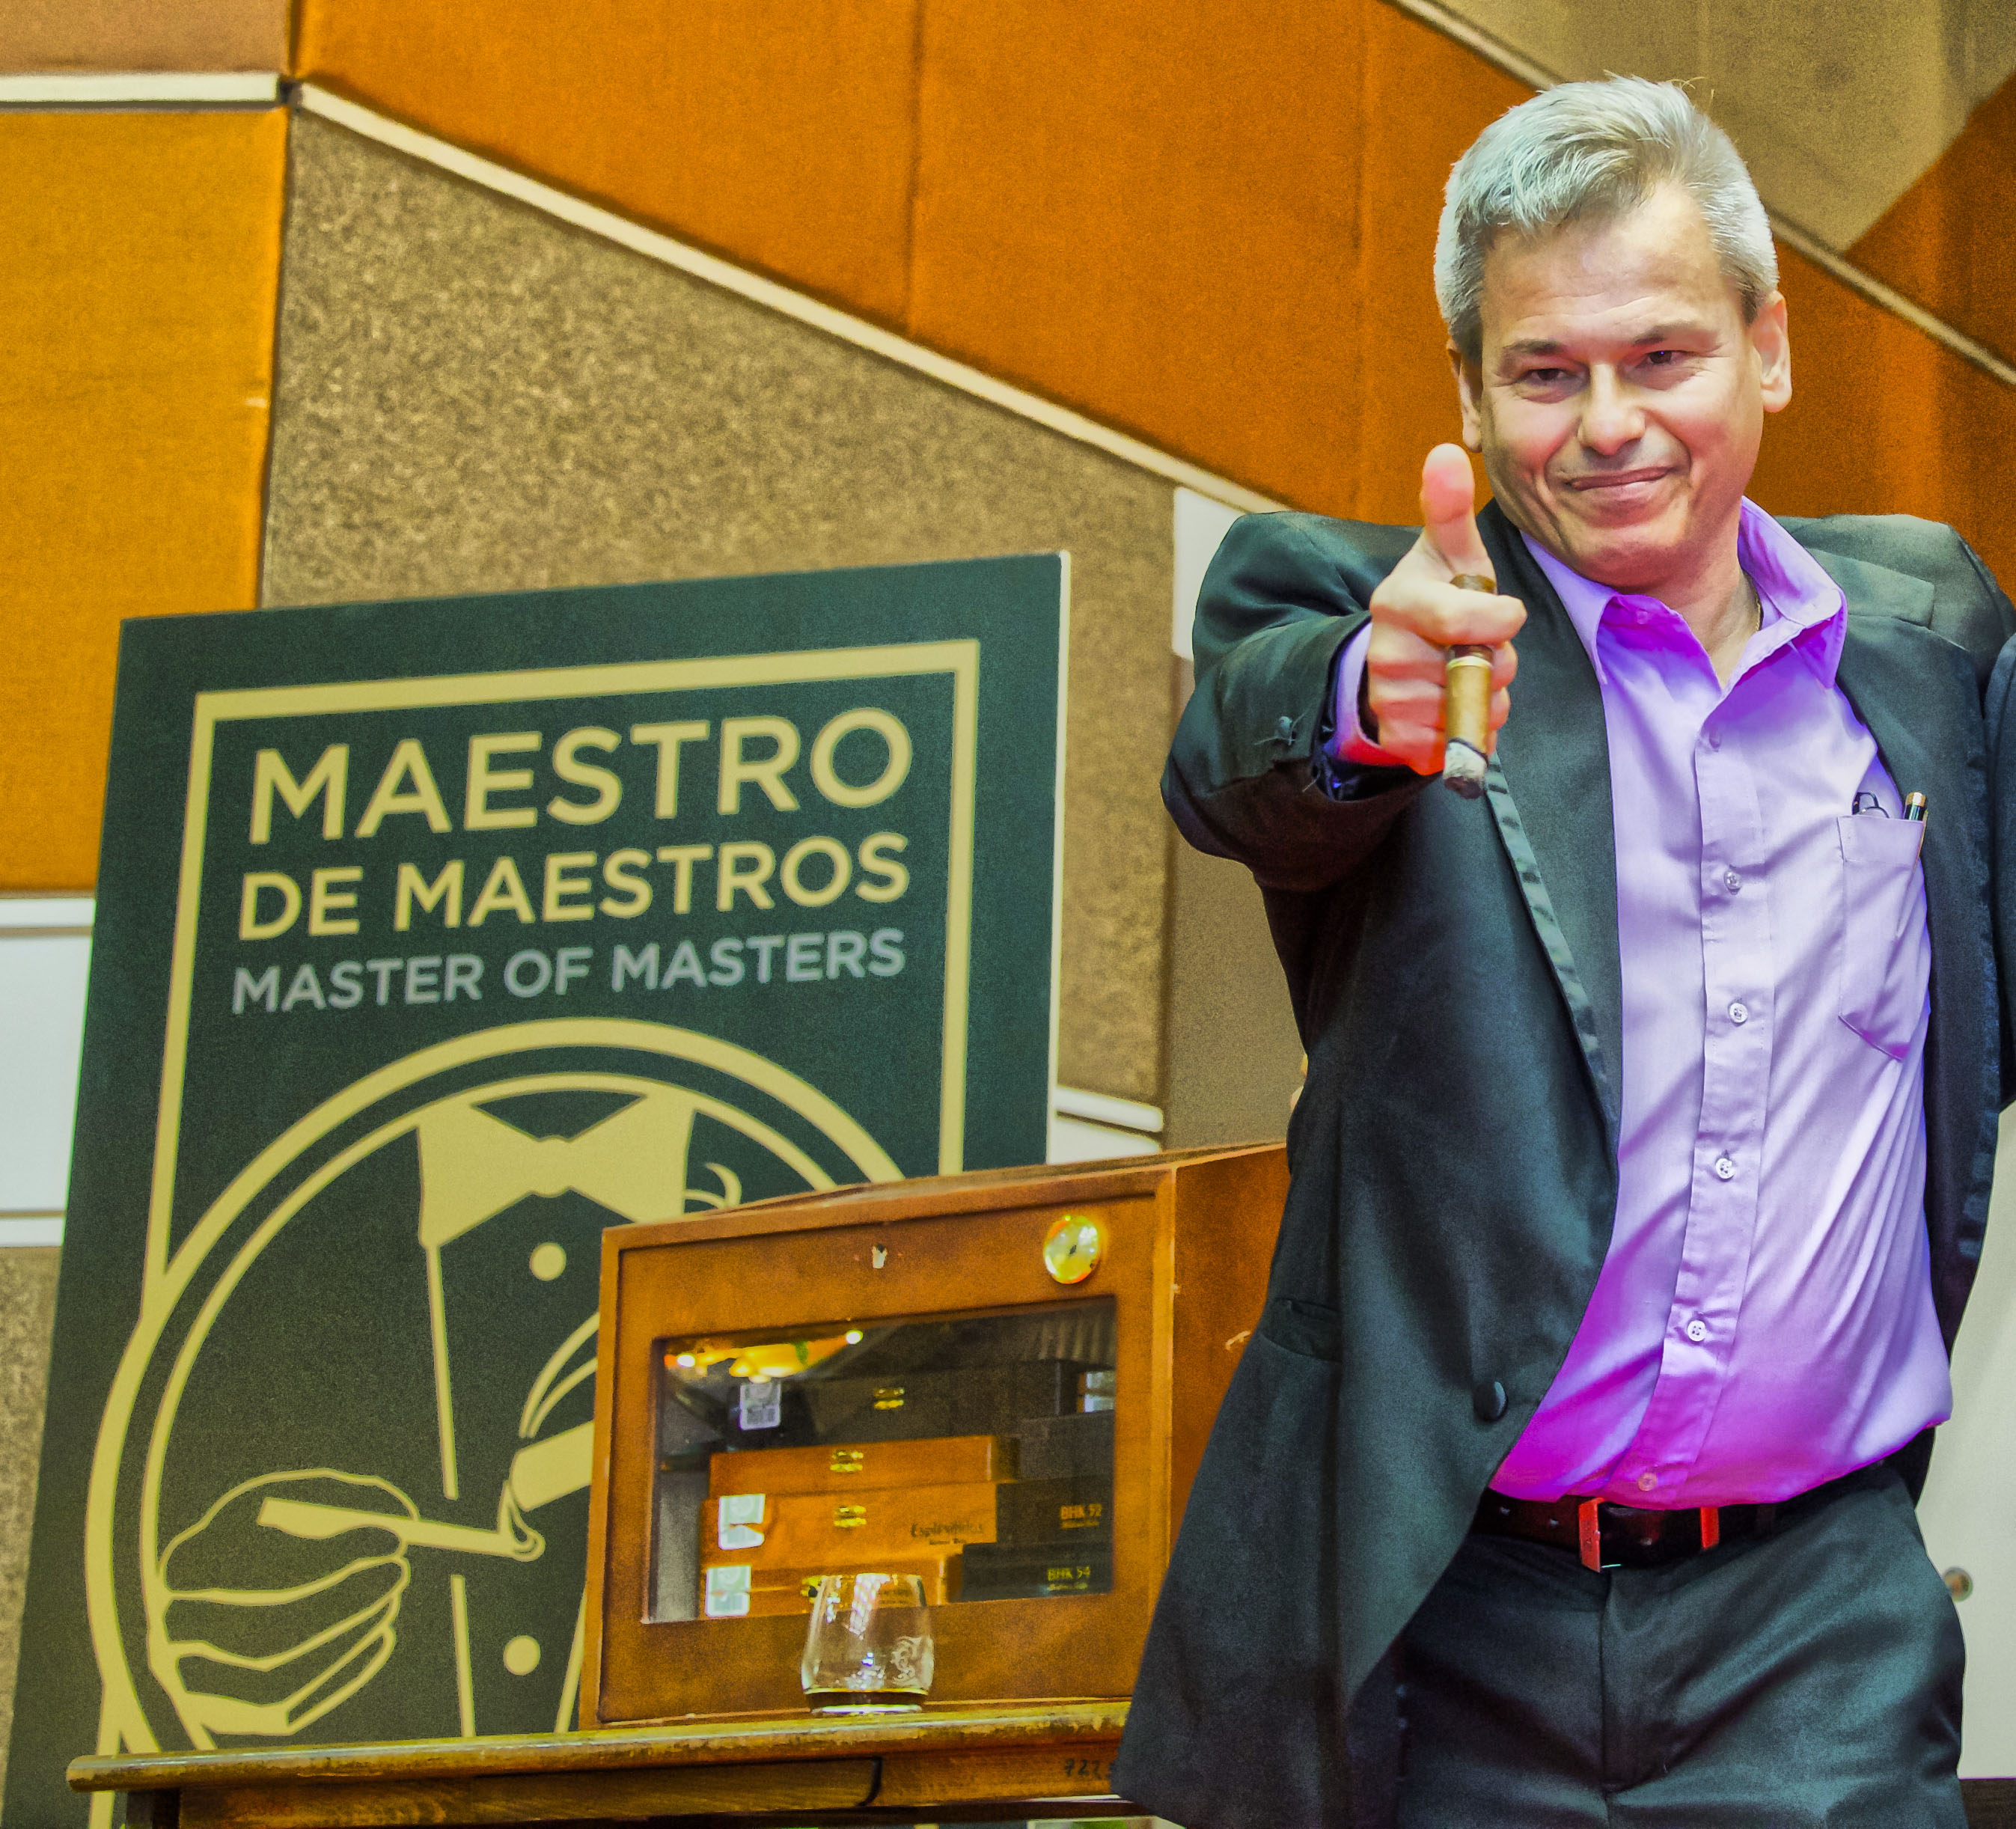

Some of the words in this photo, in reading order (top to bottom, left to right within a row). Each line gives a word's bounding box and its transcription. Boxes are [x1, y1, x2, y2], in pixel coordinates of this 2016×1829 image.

[250, 707, 913, 844] MAESTRO
[239, 867, 363, 940] DE
[394, 831, 910, 931] MAESTROS
[232, 954, 483, 1015] MASTER
[504, 947, 593, 998] OF
[611, 928, 905, 992] MASTERS
